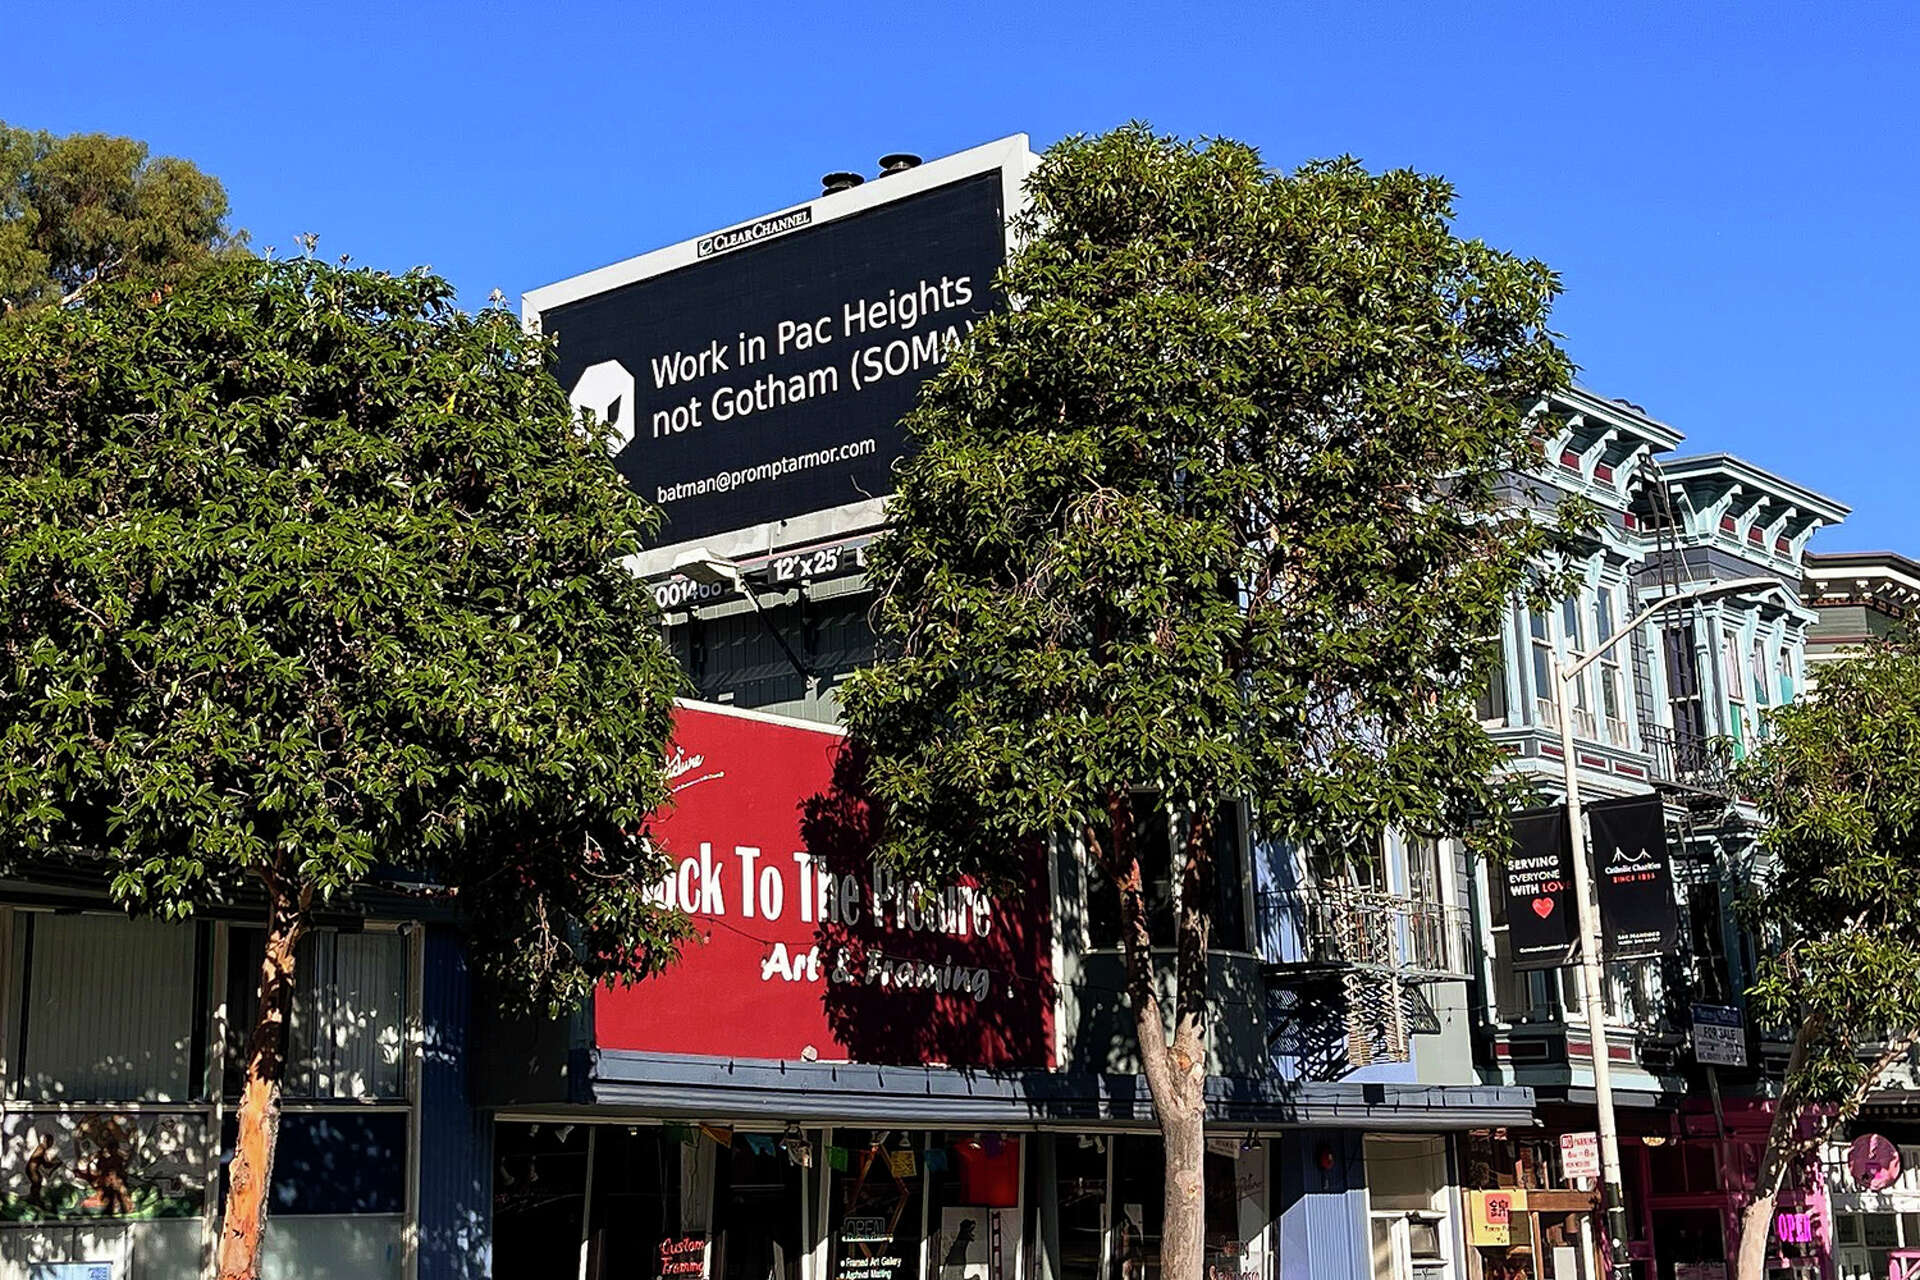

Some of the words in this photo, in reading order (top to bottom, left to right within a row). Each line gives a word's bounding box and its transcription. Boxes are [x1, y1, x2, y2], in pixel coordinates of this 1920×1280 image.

[652, 340, 729, 389] Work
[740, 333, 765, 365] in
[778, 317, 832, 355] Pac
[844, 276, 973, 338] Heights
[653, 397, 702, 437] not
[711, 366, 838, 421] Gotham
[657, 438, 875, 503] batman@promptarmor.com
[1508, 855, 1559, 871] SERVING
[1509, 869, 1560, 884] EVERYONE
[735, 845, 783, 922] To
[793, 852, 860, 926] The
[1510, 884, 1540, 896] WITH
[761, 943, 820, 982] Art
[832, 947, 854, 983] &
[865, 949, 990, 1002] Framing
[847, 1219, 884, 1235] OPEN
[1778, 1213, 1812, 1242] OPEN
[660, 1237, 705, 1255] Custom
